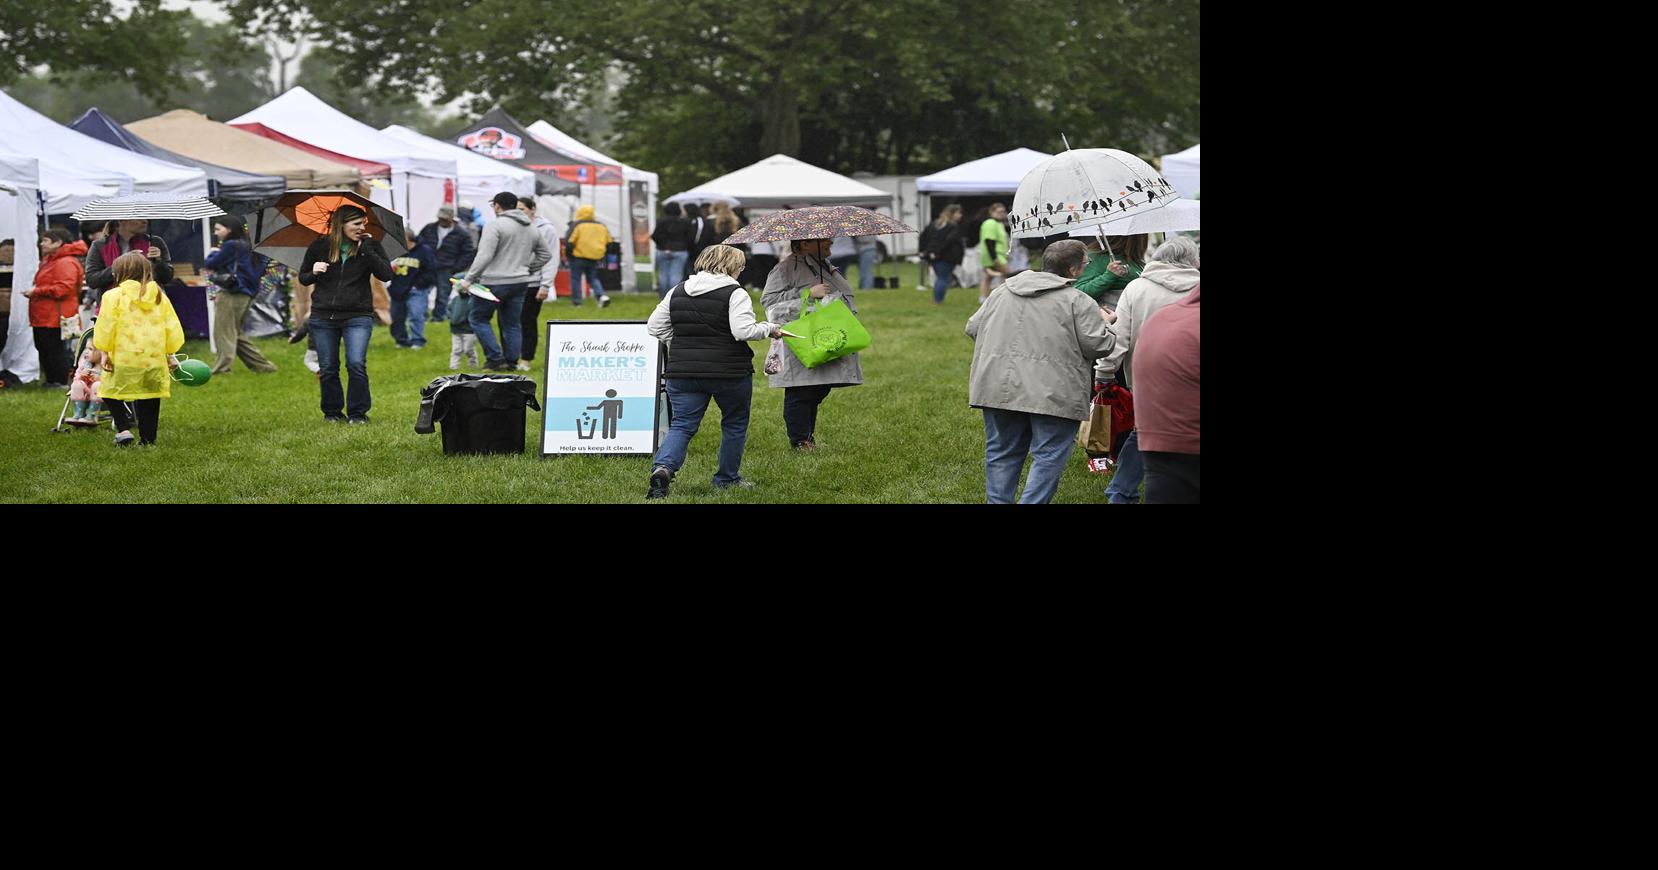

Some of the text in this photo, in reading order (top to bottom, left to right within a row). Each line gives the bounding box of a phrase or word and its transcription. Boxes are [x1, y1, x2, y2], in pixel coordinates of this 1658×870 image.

[560, 341, 576, 353] The
[558, 356, 646, 368] MAKER'S
[557, 368, 647, 381] MARKET
